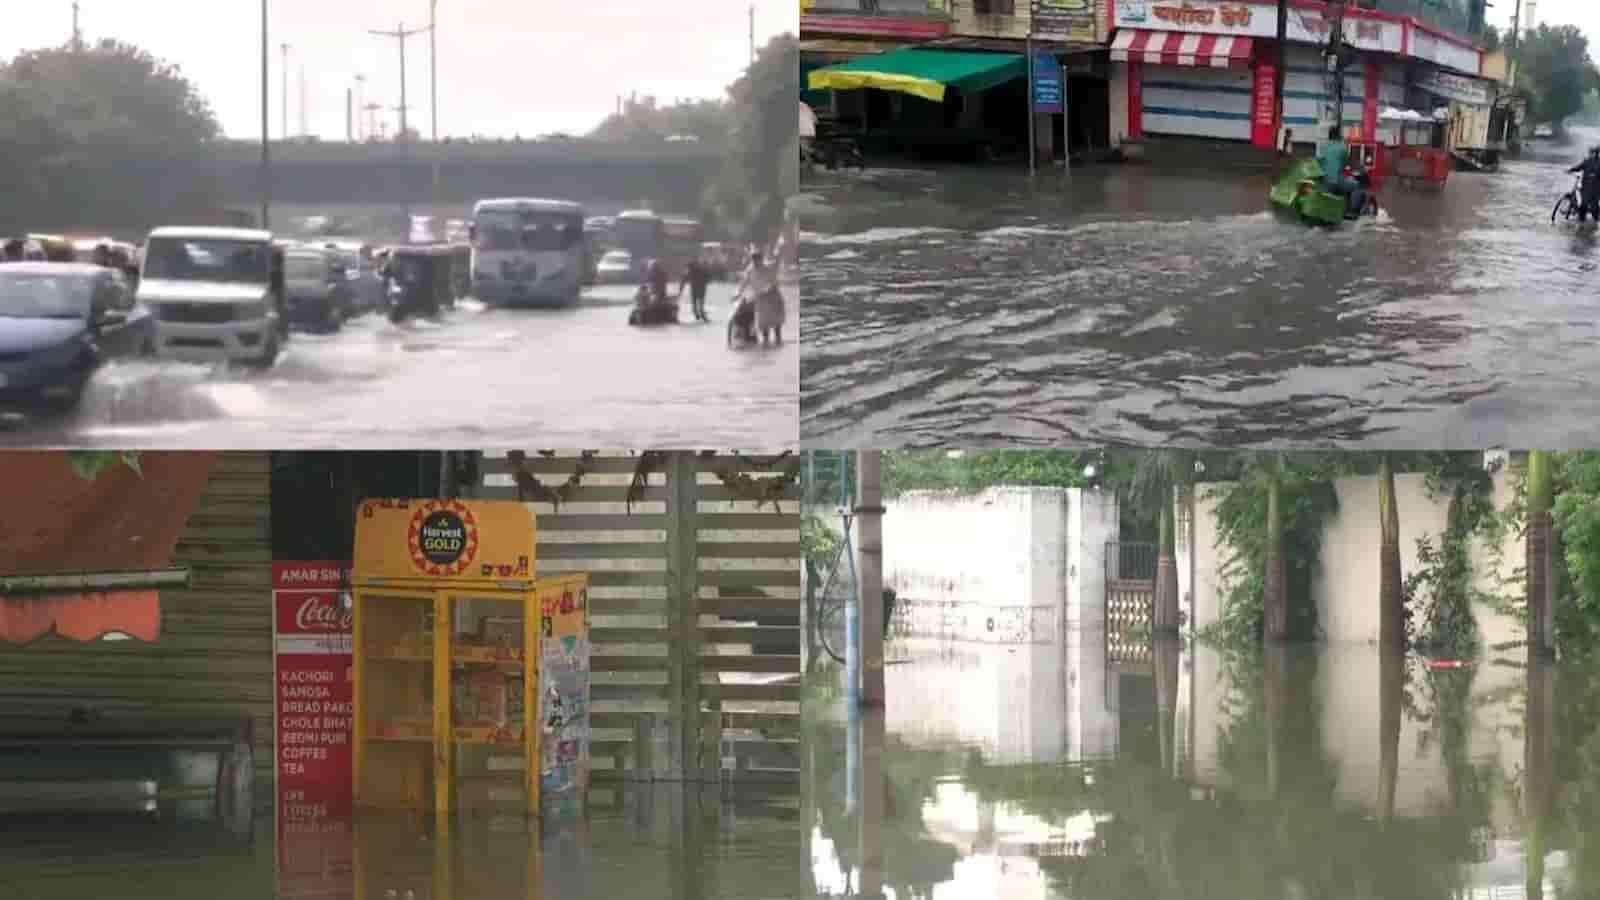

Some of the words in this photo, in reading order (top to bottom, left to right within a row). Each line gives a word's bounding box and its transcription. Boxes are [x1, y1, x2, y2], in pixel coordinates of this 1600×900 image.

[423, 527, 463, 538] Harvest
[424, 538, 461, 550] GOLD
[281, 568, 318, 582] AMAR
[281, 671, 334, 682] KACHORI
[281, 686, 330, 697] SAMOSA
[282, 701, 320, 712] BREAD
[282, 717, 320, 729] CHOLE
[282, 748, 328, 760] COFFEE
[282, 762, 304, 775] TEA
